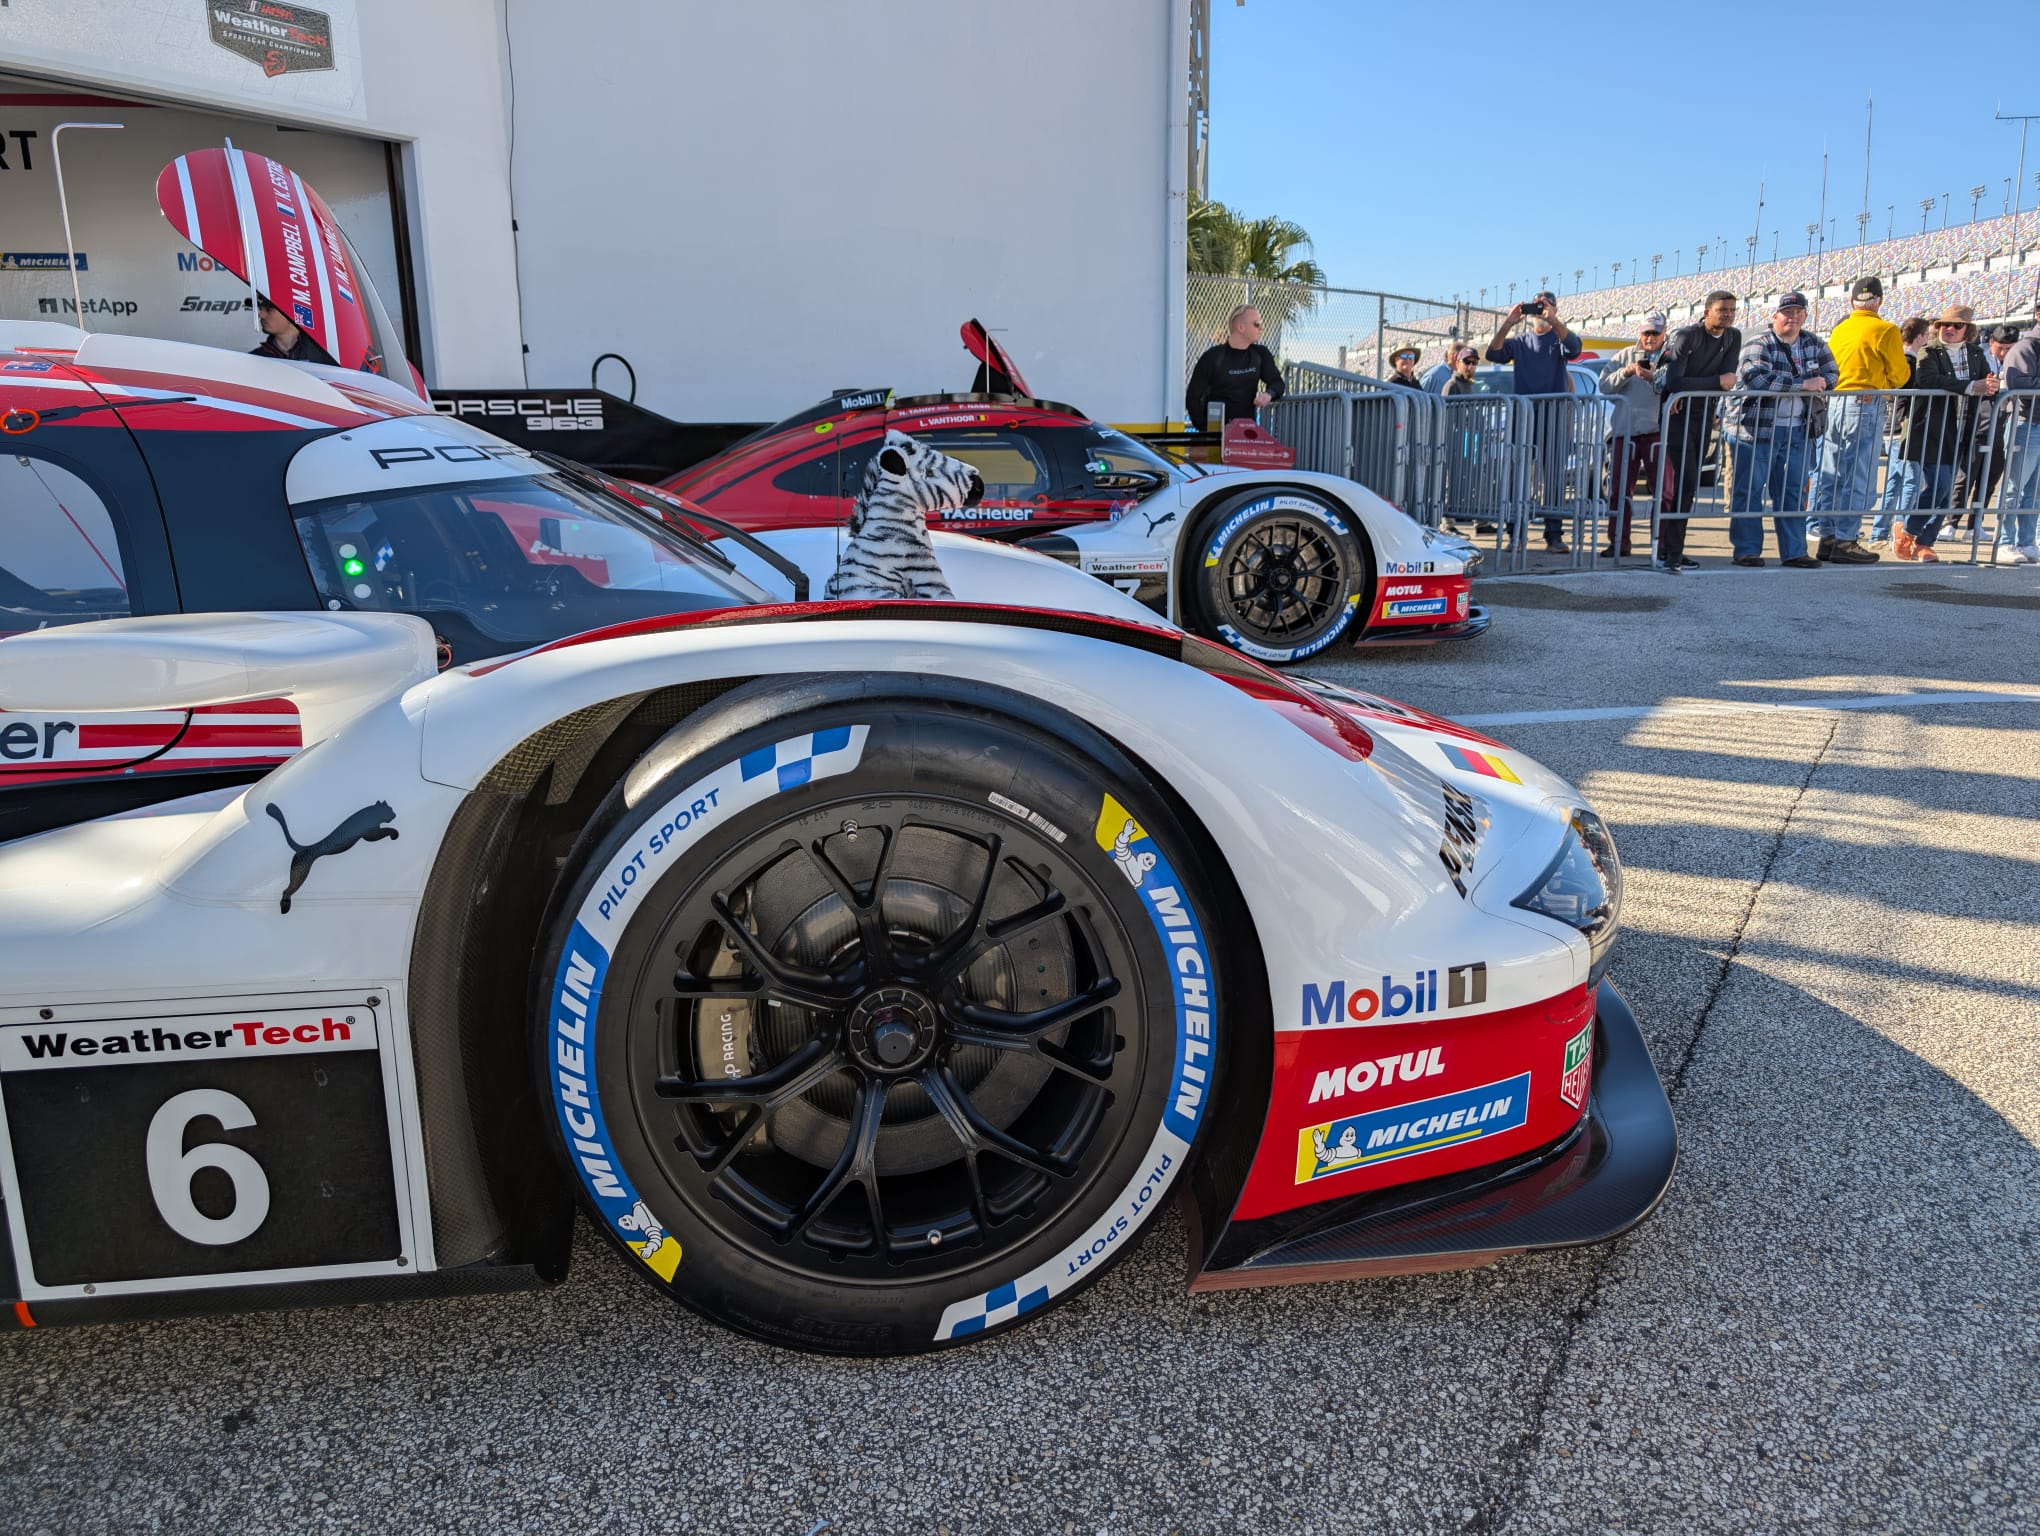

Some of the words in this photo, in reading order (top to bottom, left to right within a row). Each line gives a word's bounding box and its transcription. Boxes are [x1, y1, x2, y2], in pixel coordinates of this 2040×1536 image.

[282, 221, 312, 287] CAMPBELL
[62, 298, 138, 316] NetApp
[292, 286, 312, 306] M.
[526, 417, 604, 430] 963
[841, 394, 872, 409] Mobil
[919, 419, 928, 427] L.
[928, 415, 975, 427] VANTHOOR
[1218, 500, 1270, 545] MICHELIN
[1385, 561, 1421, 574] Mobil
[1385, 585, 1423, 597] MOTUL
[1401, 603, 1442, 613] MICHELIN
[598, 850, 647, 920] PILOT
[649, 788, 720, 854] SPORT
[1148, 885, 1210, 1121] MICHELIN
[1302, 969, 1437, 1026] Mobil
[721, 1013, 734, 1061] RACING
[1568, 1024, 1592, 1066] TAG
[557, 950, 628, 1198] MICHELIN
[1308, 1046, 1446, 1104] MOTUL
[1366, 1096, 1512, 1150] MICHELIN
[146, 1088, 270, 1246] 6
[1130, 1154, 1172, 1217] PILOT
[1067, 1215, 1129, 1277] SPORT
